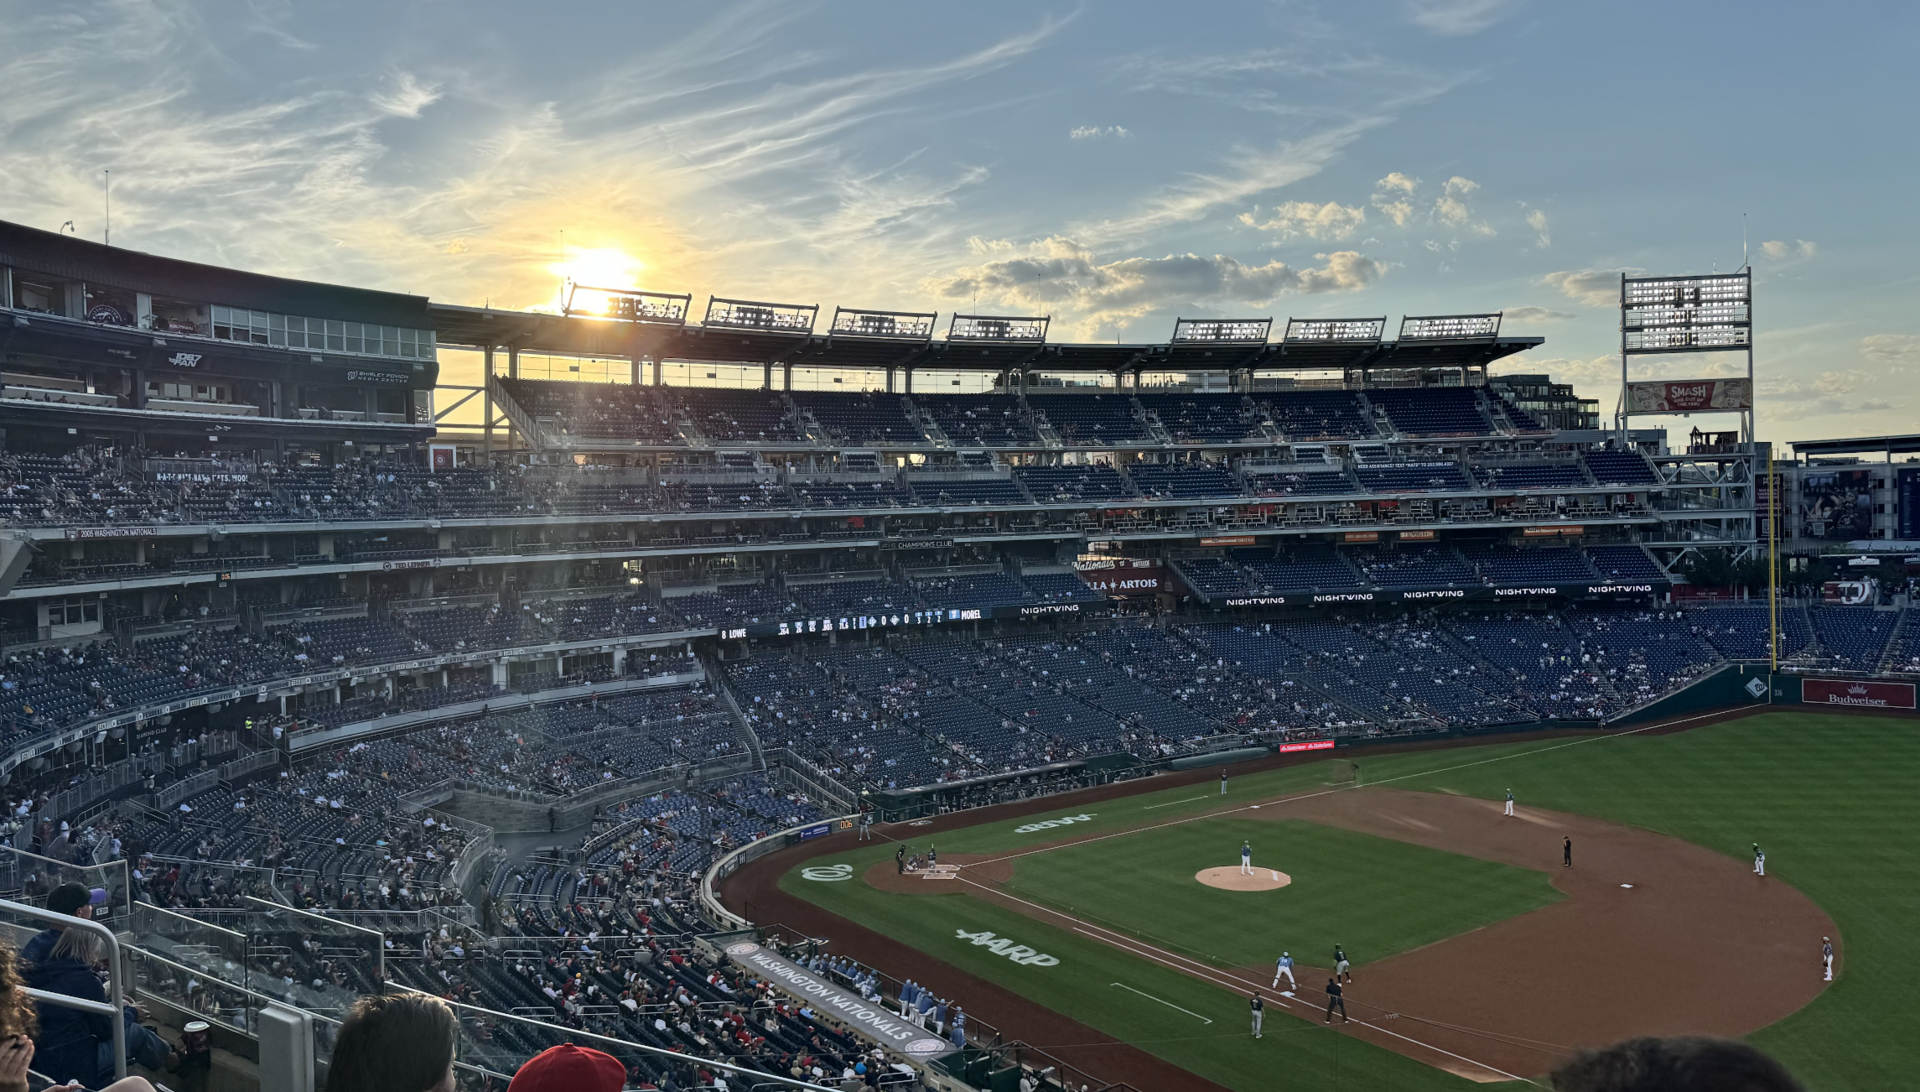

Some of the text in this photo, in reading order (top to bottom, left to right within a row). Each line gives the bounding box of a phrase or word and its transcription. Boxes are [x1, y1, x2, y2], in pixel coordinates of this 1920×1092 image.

[1671, 385, 1706, 398] SMASH
[80, 528, 157, 538] 2005 WASHINGTON NATIONALS
[1119, 579, 1158, 589] ARTOIS
[1589, 585, 1652, 593] NIGHTWING
[1314, 594, 1373, 602] NIGHTWING
[1403, 590, 1464, 599] NIGHTWING
[1227, 597, 1285, 606] NIGHTWING
[961, 609, 982, 620] MOREL
[1021, 605, 1079, 615] NIGHTWING
[881, 615, 887, 626] 0
[904, 614, 910, 624] 0
[927, 616, 931, 624] 2
[937, 615, 941, 623] 2
[721, 628, 746, 639] 8 LOWE
[311, 673, 342, 683] KILLEBREW
[1829, 694, 1887, 706] Budweiser
[136, 727, 167, 740] DIAMOND CLUB
[954, 929, 1060, 967] AARP
[749, 952, 914, 1041] WASHINGTON NATIONALS
